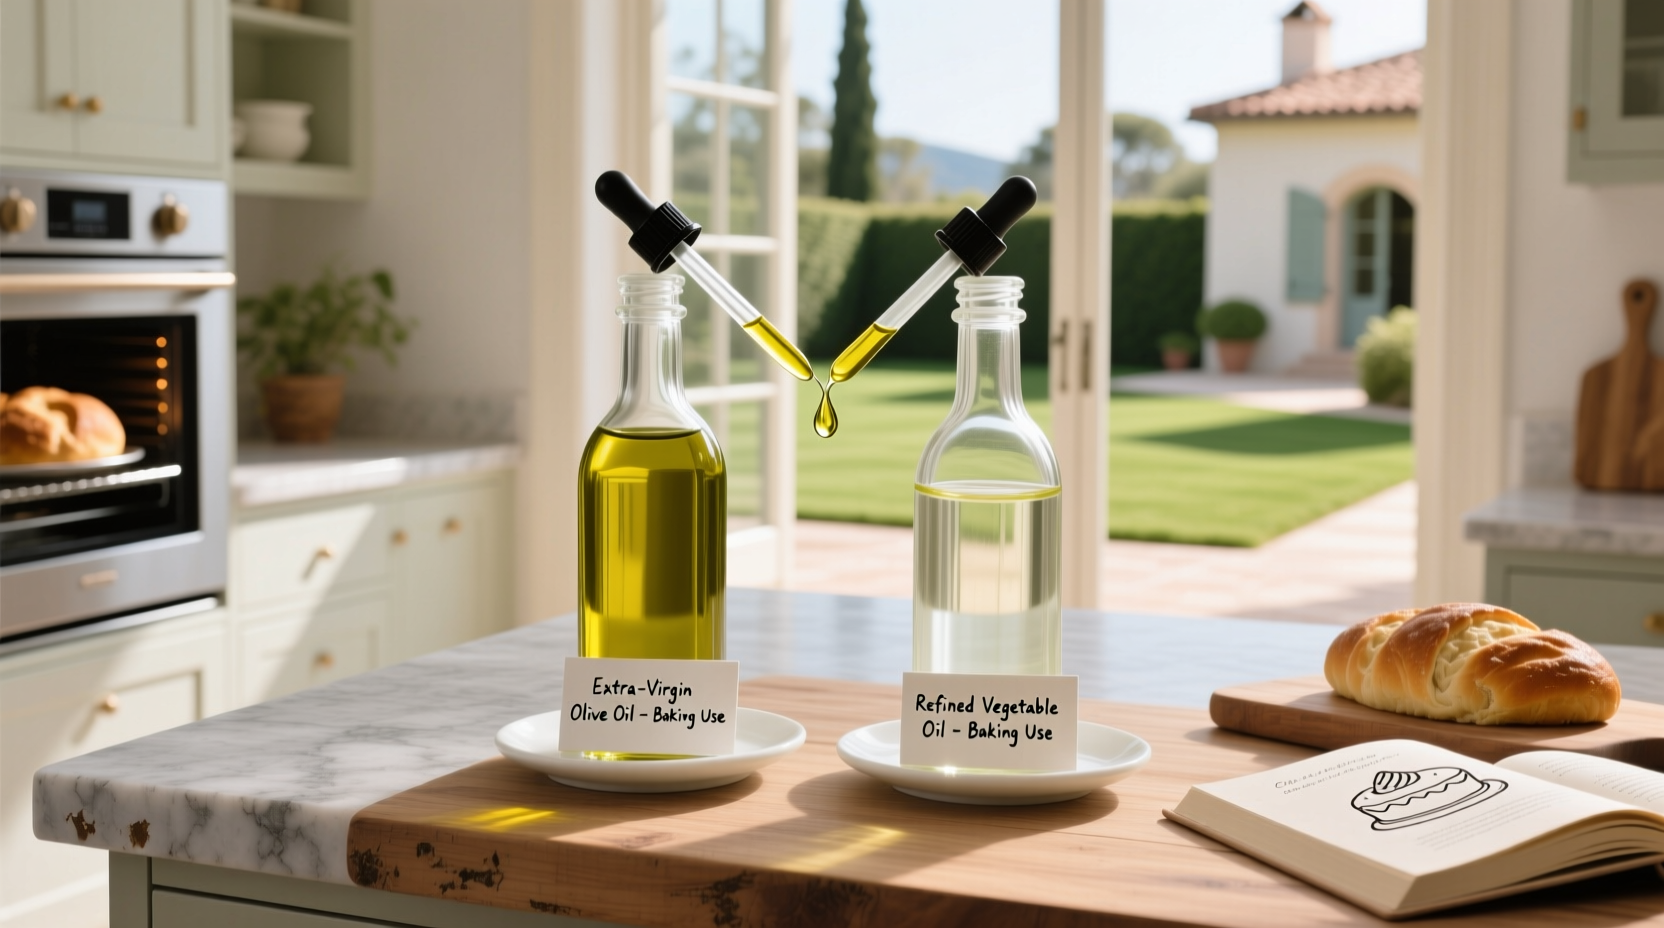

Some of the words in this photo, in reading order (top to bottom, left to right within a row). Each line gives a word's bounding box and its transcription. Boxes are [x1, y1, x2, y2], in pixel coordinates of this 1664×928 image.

[593, 677, 692, 704] Extra-Virgin
[570, 702, 608, 722] Olive
[613, 704, 635, 722] Oil
[701, 709, 726, 724] Use
[915, 693, 975, 714] Refined
[982, 696, 1059, 721] Vegetable
[922, 719, 946, 738] Oil
[968, 720, 1018, 748] Baking
[1025, 723, 1053, 741] Use
